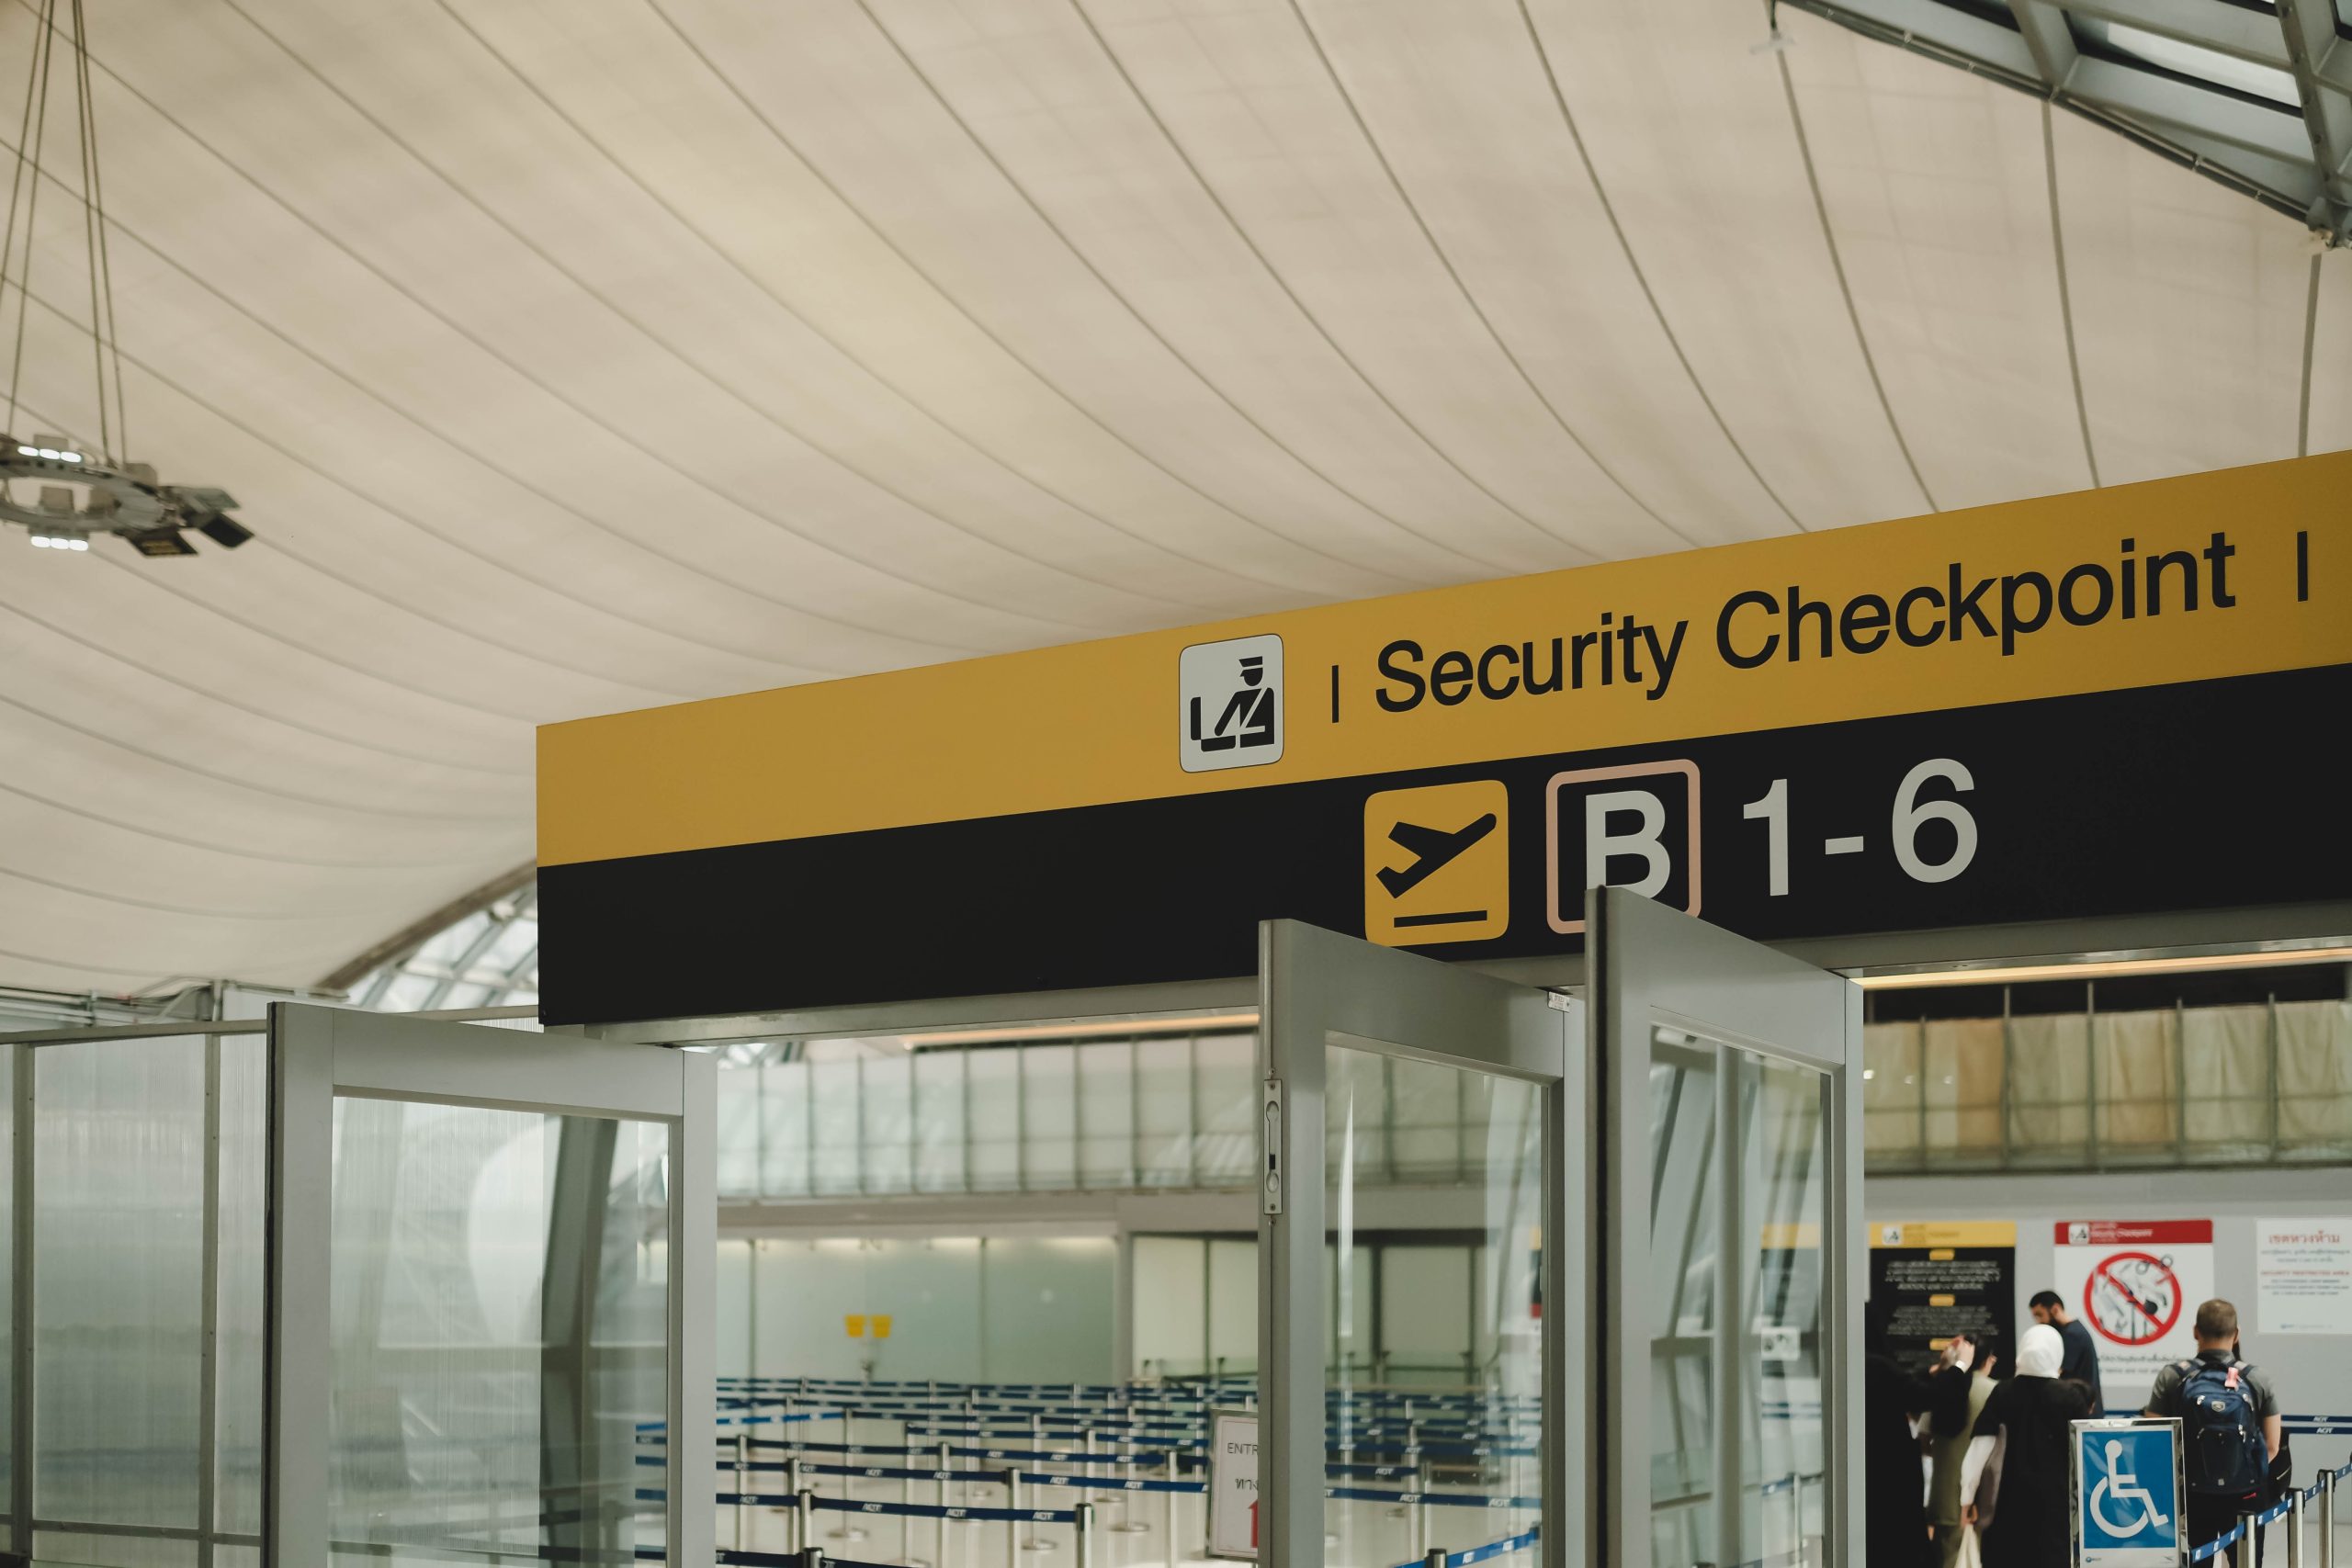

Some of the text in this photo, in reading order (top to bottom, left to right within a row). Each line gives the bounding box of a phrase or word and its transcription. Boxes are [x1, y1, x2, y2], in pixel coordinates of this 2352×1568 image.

[1375, 531, 2236, 714] Security Checkpoint
[1585, 789, 1671, 899] B
